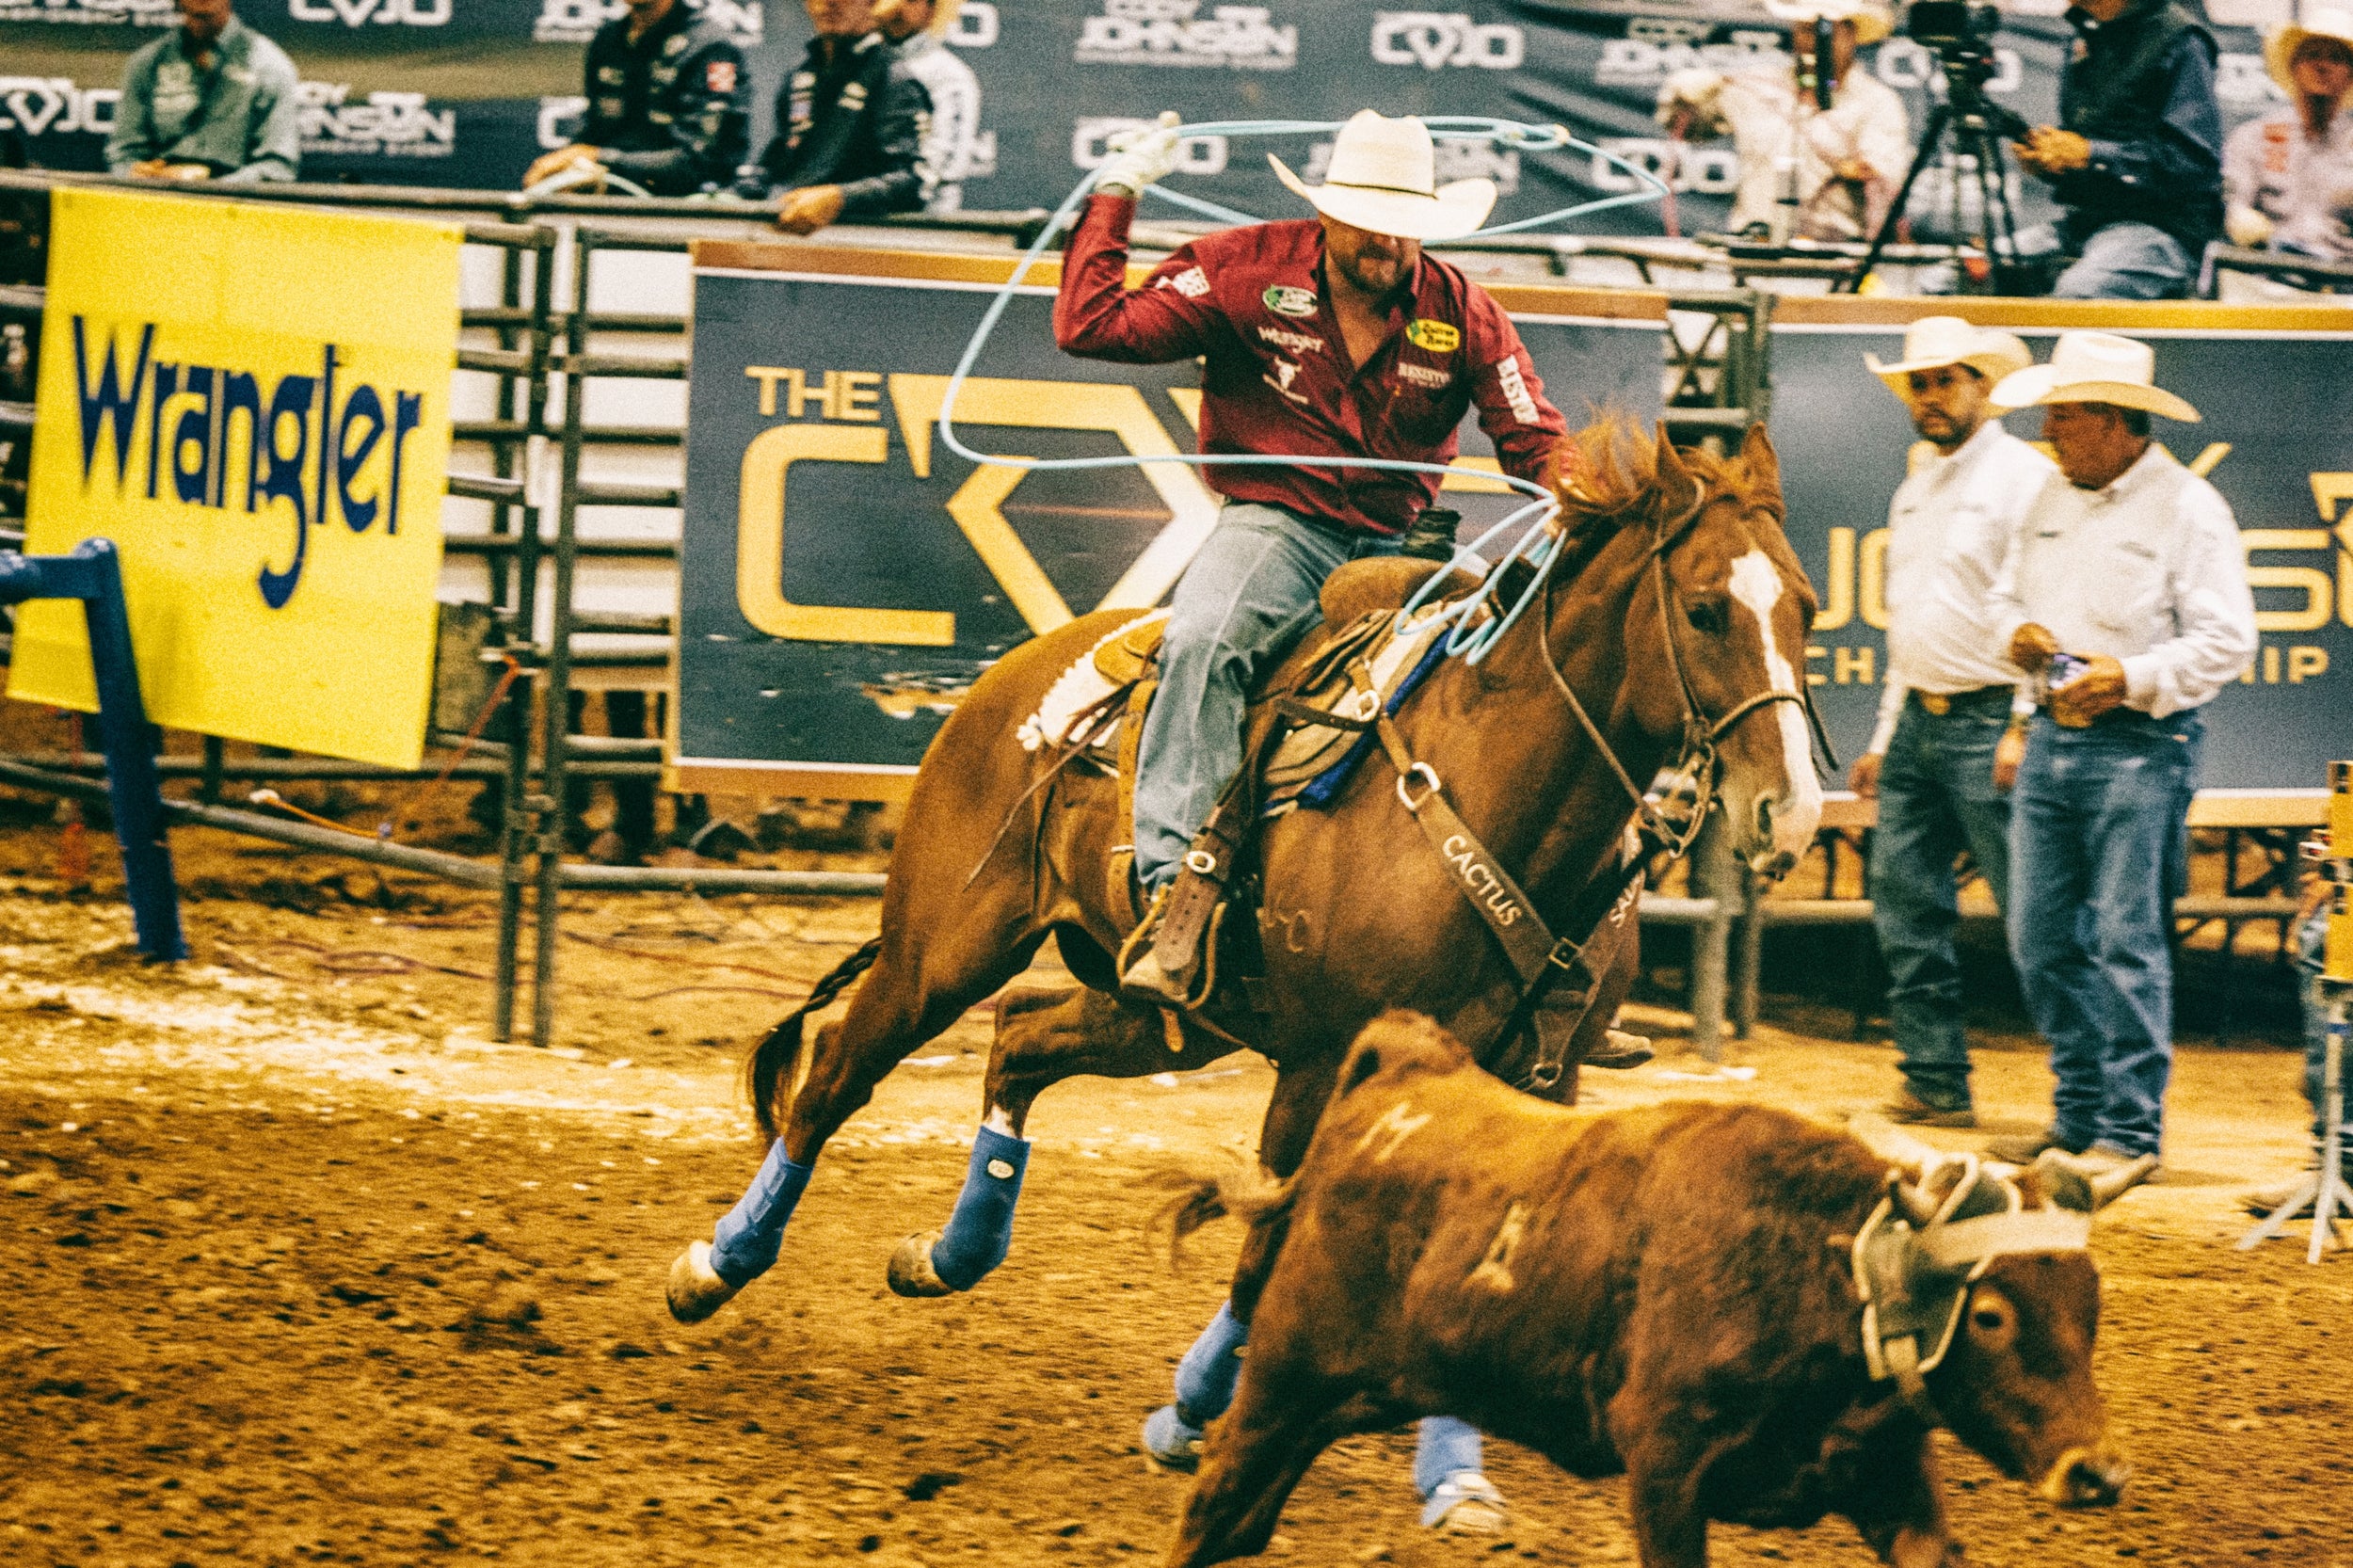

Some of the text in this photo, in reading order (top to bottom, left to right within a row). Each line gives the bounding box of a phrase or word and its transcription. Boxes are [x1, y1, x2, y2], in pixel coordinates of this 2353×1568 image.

[744, 364, 883, 422] THE
[71, 314, 424, 610] Wrangler
[1442, 834, 1523, 927] CACTUS
